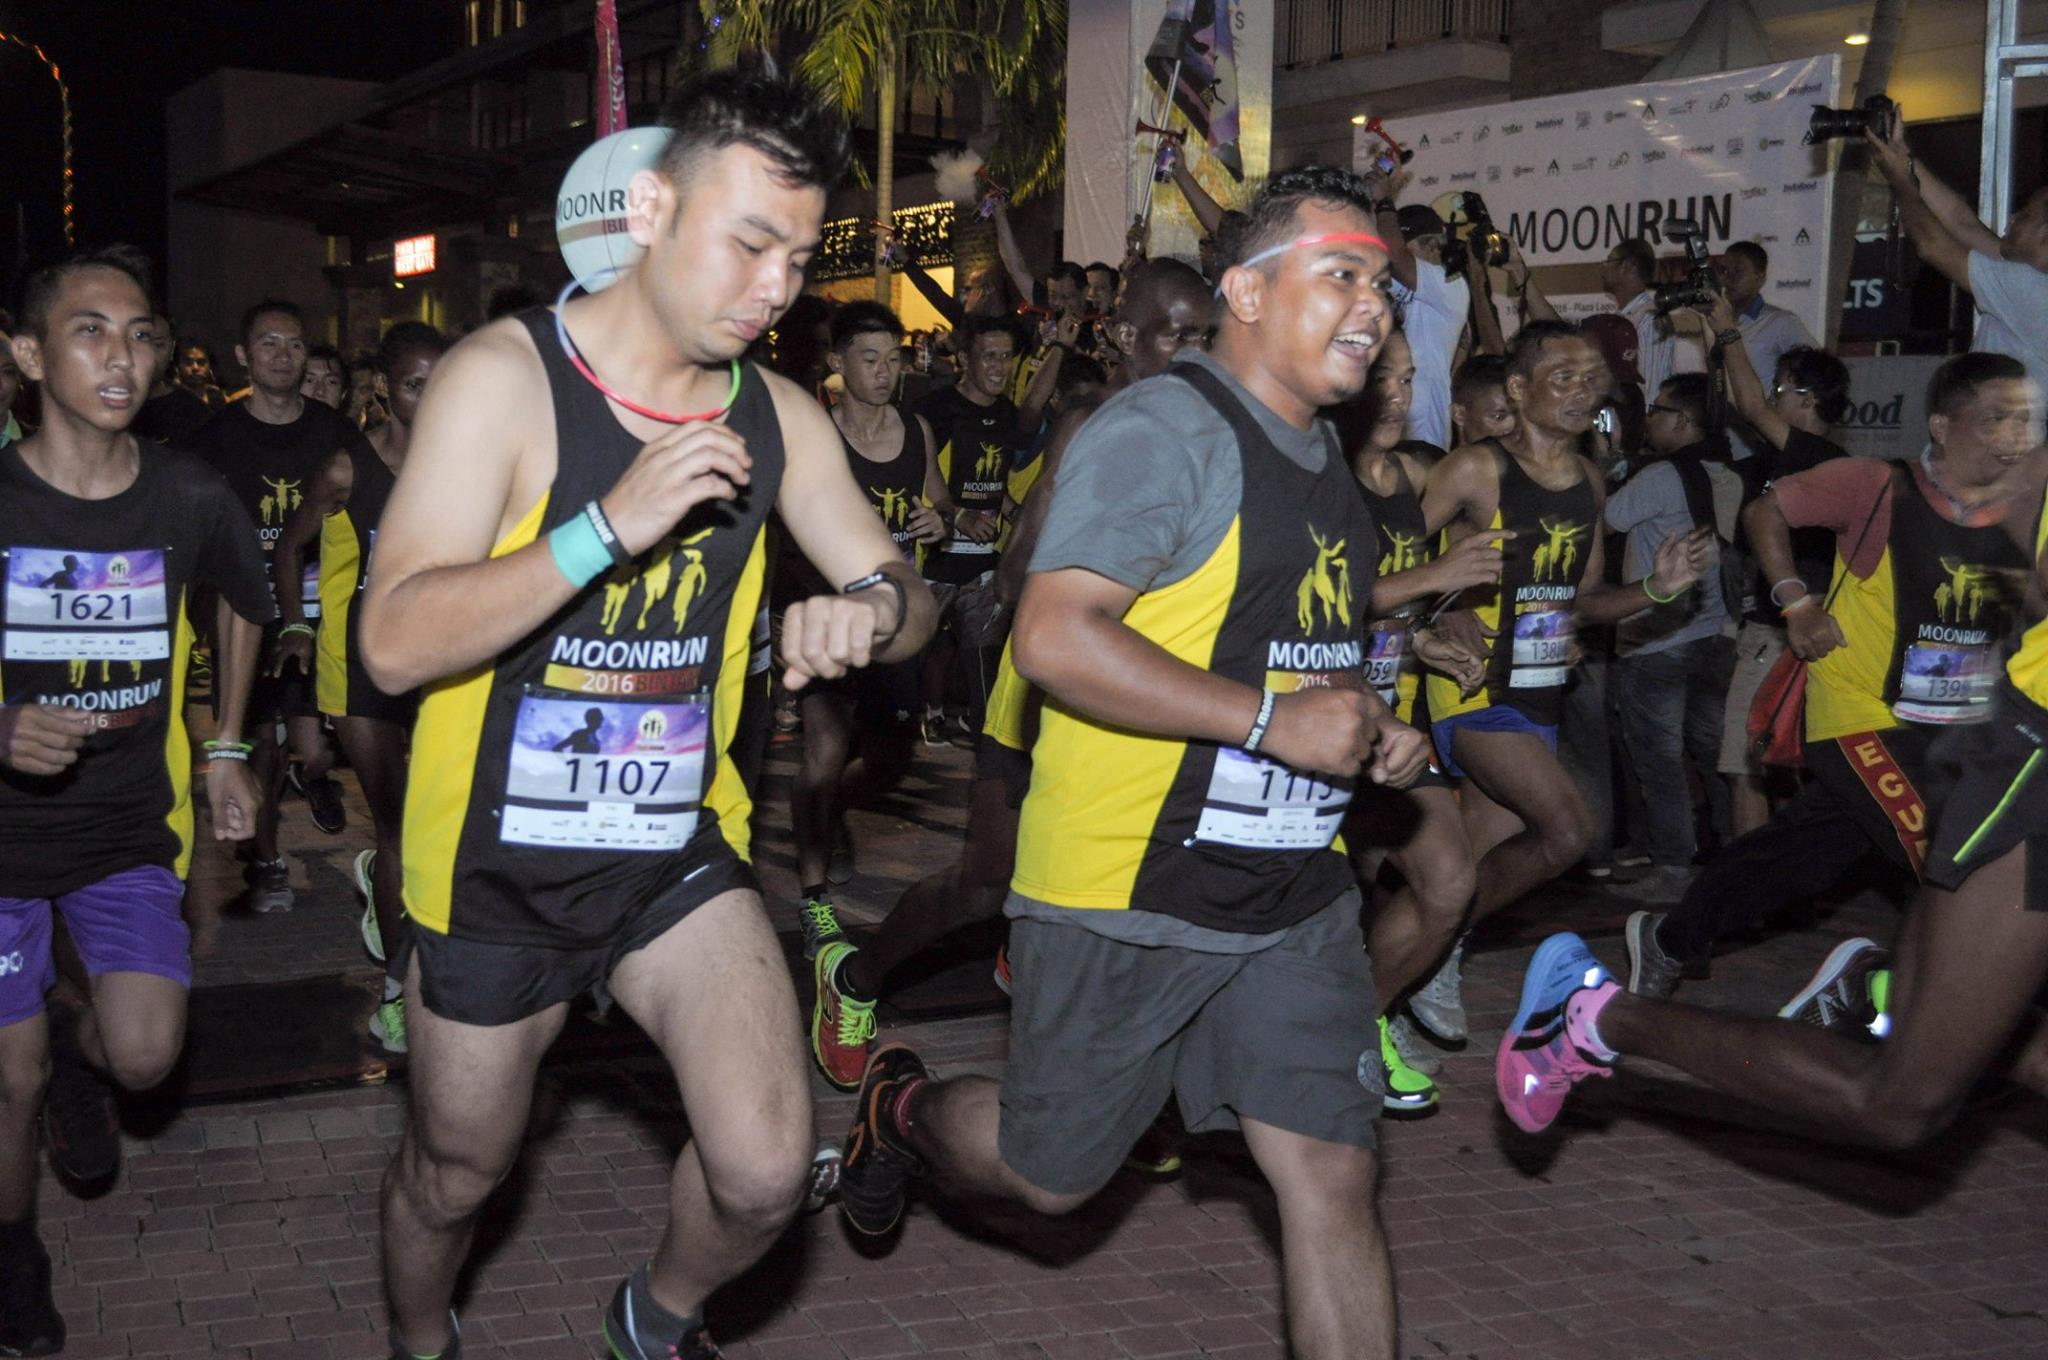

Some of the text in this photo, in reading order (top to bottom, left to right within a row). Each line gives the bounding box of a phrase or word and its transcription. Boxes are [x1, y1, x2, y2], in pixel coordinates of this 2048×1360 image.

[1508, 192, 1733, 255] MOONRUN
[51, 593, 131, 620] 1621
[551, 635, 708, 669] MOONRUN
[1267, 640, 1361, 669] MOONRUN
[581, 672, 634, 693] 2016
[1363, 660, 1392, 681] 059
[39, 677, 162, 711] MOONRUN
[565, 757, 671, 796] 1107
